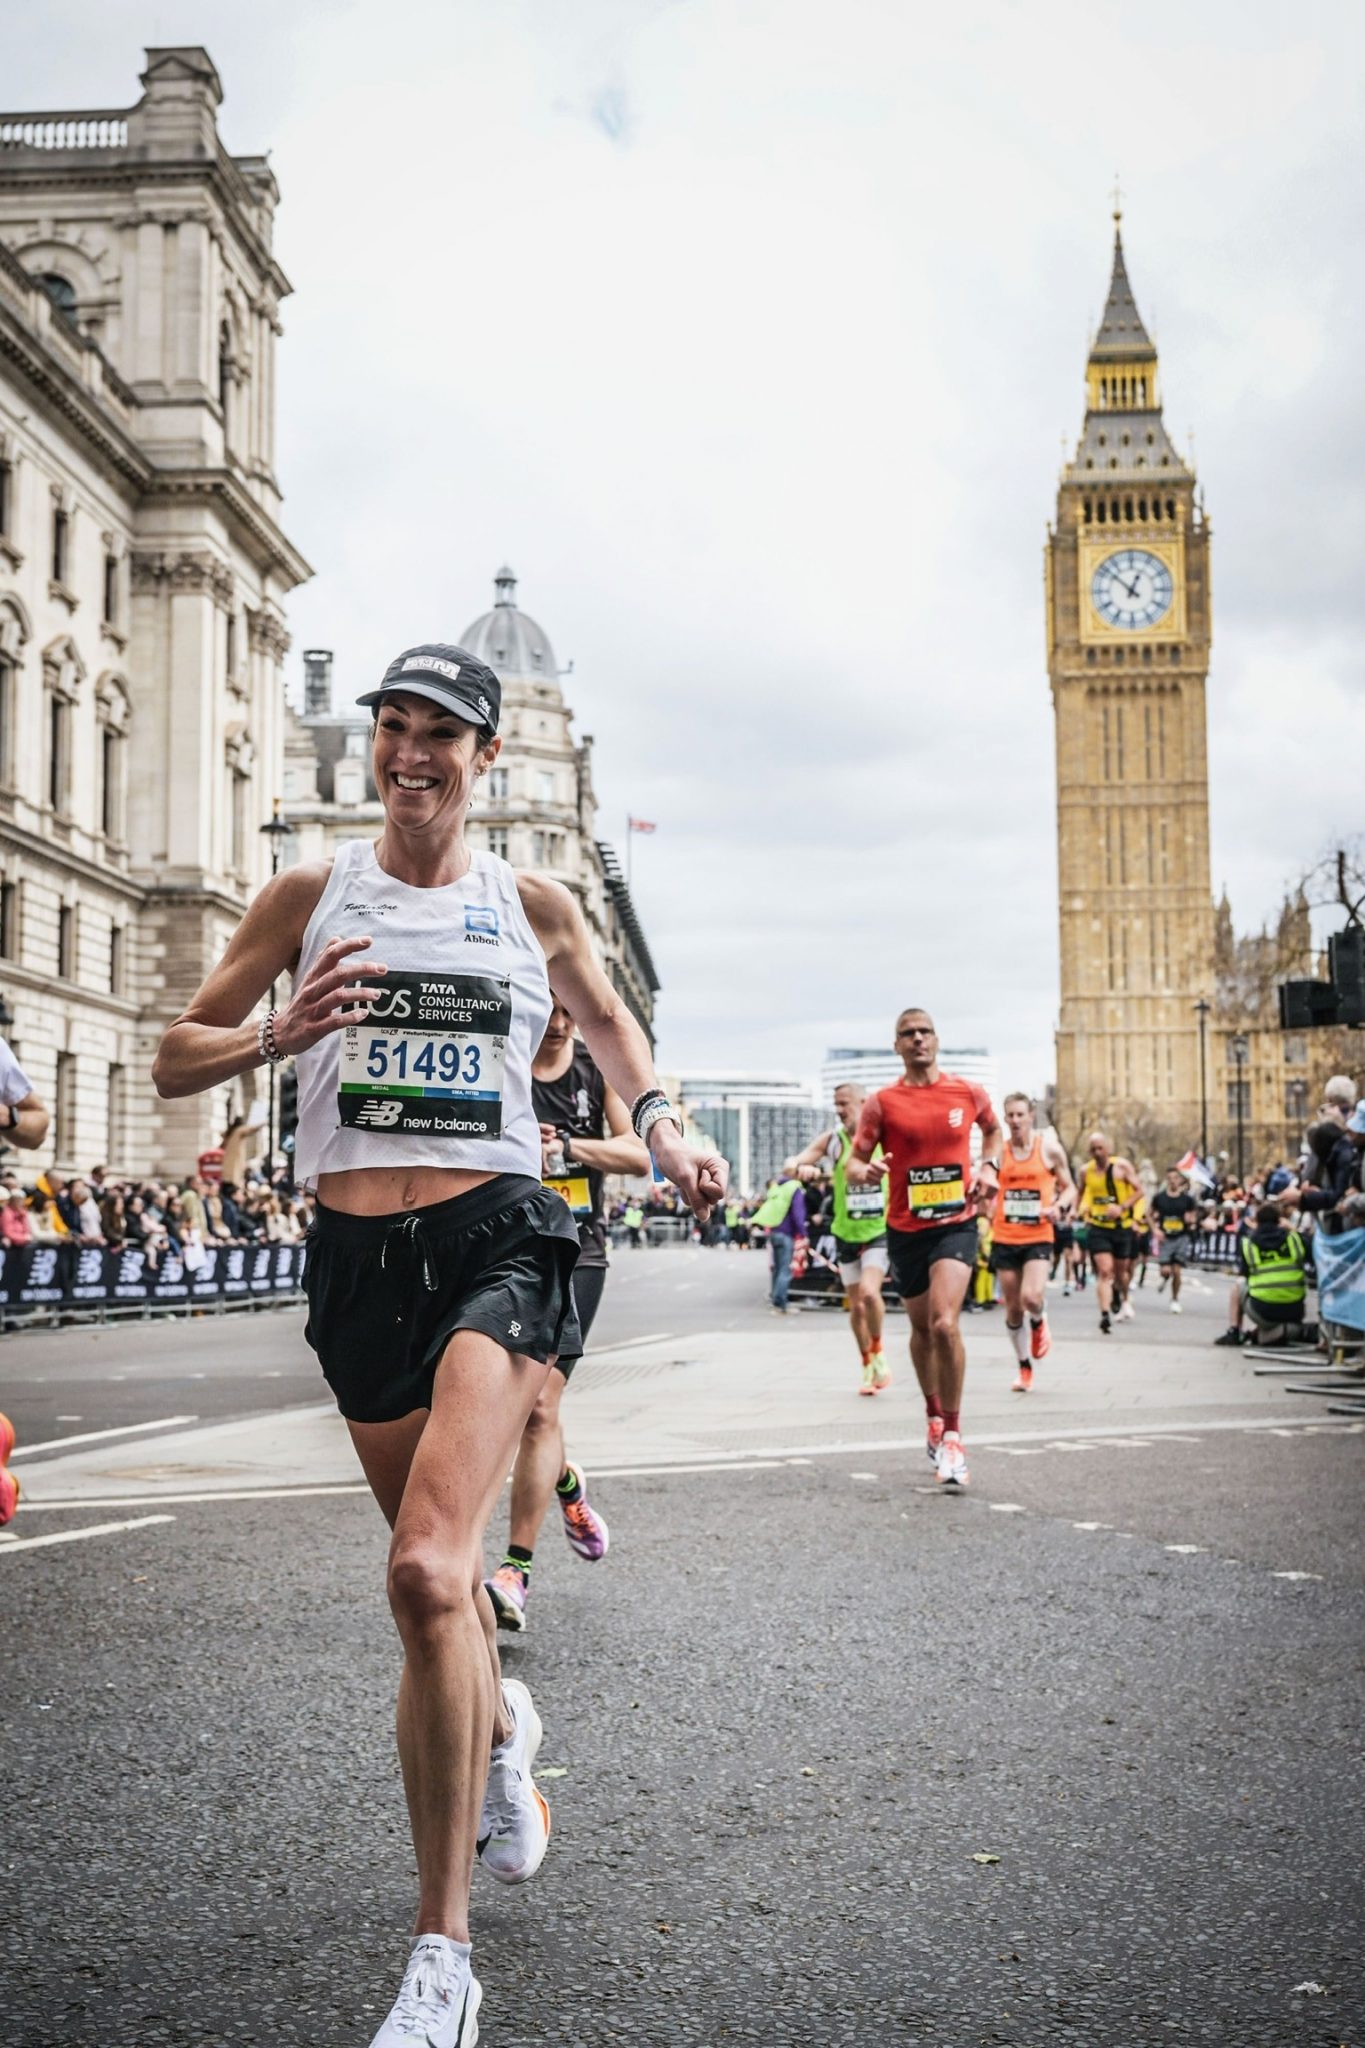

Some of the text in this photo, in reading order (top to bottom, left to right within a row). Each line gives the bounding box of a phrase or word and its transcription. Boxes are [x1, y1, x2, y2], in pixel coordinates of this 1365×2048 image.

[464, 934, 500, 947] Abbott
[420, 983, 456, 995] TATA
[419, 996, 502, 1012] CONSULTANCY
[418, 1009, 472, 1022] SERVICES
[366, 1039, 481, 1084] 51493
[403, 1117, 487, 1132] new balance
